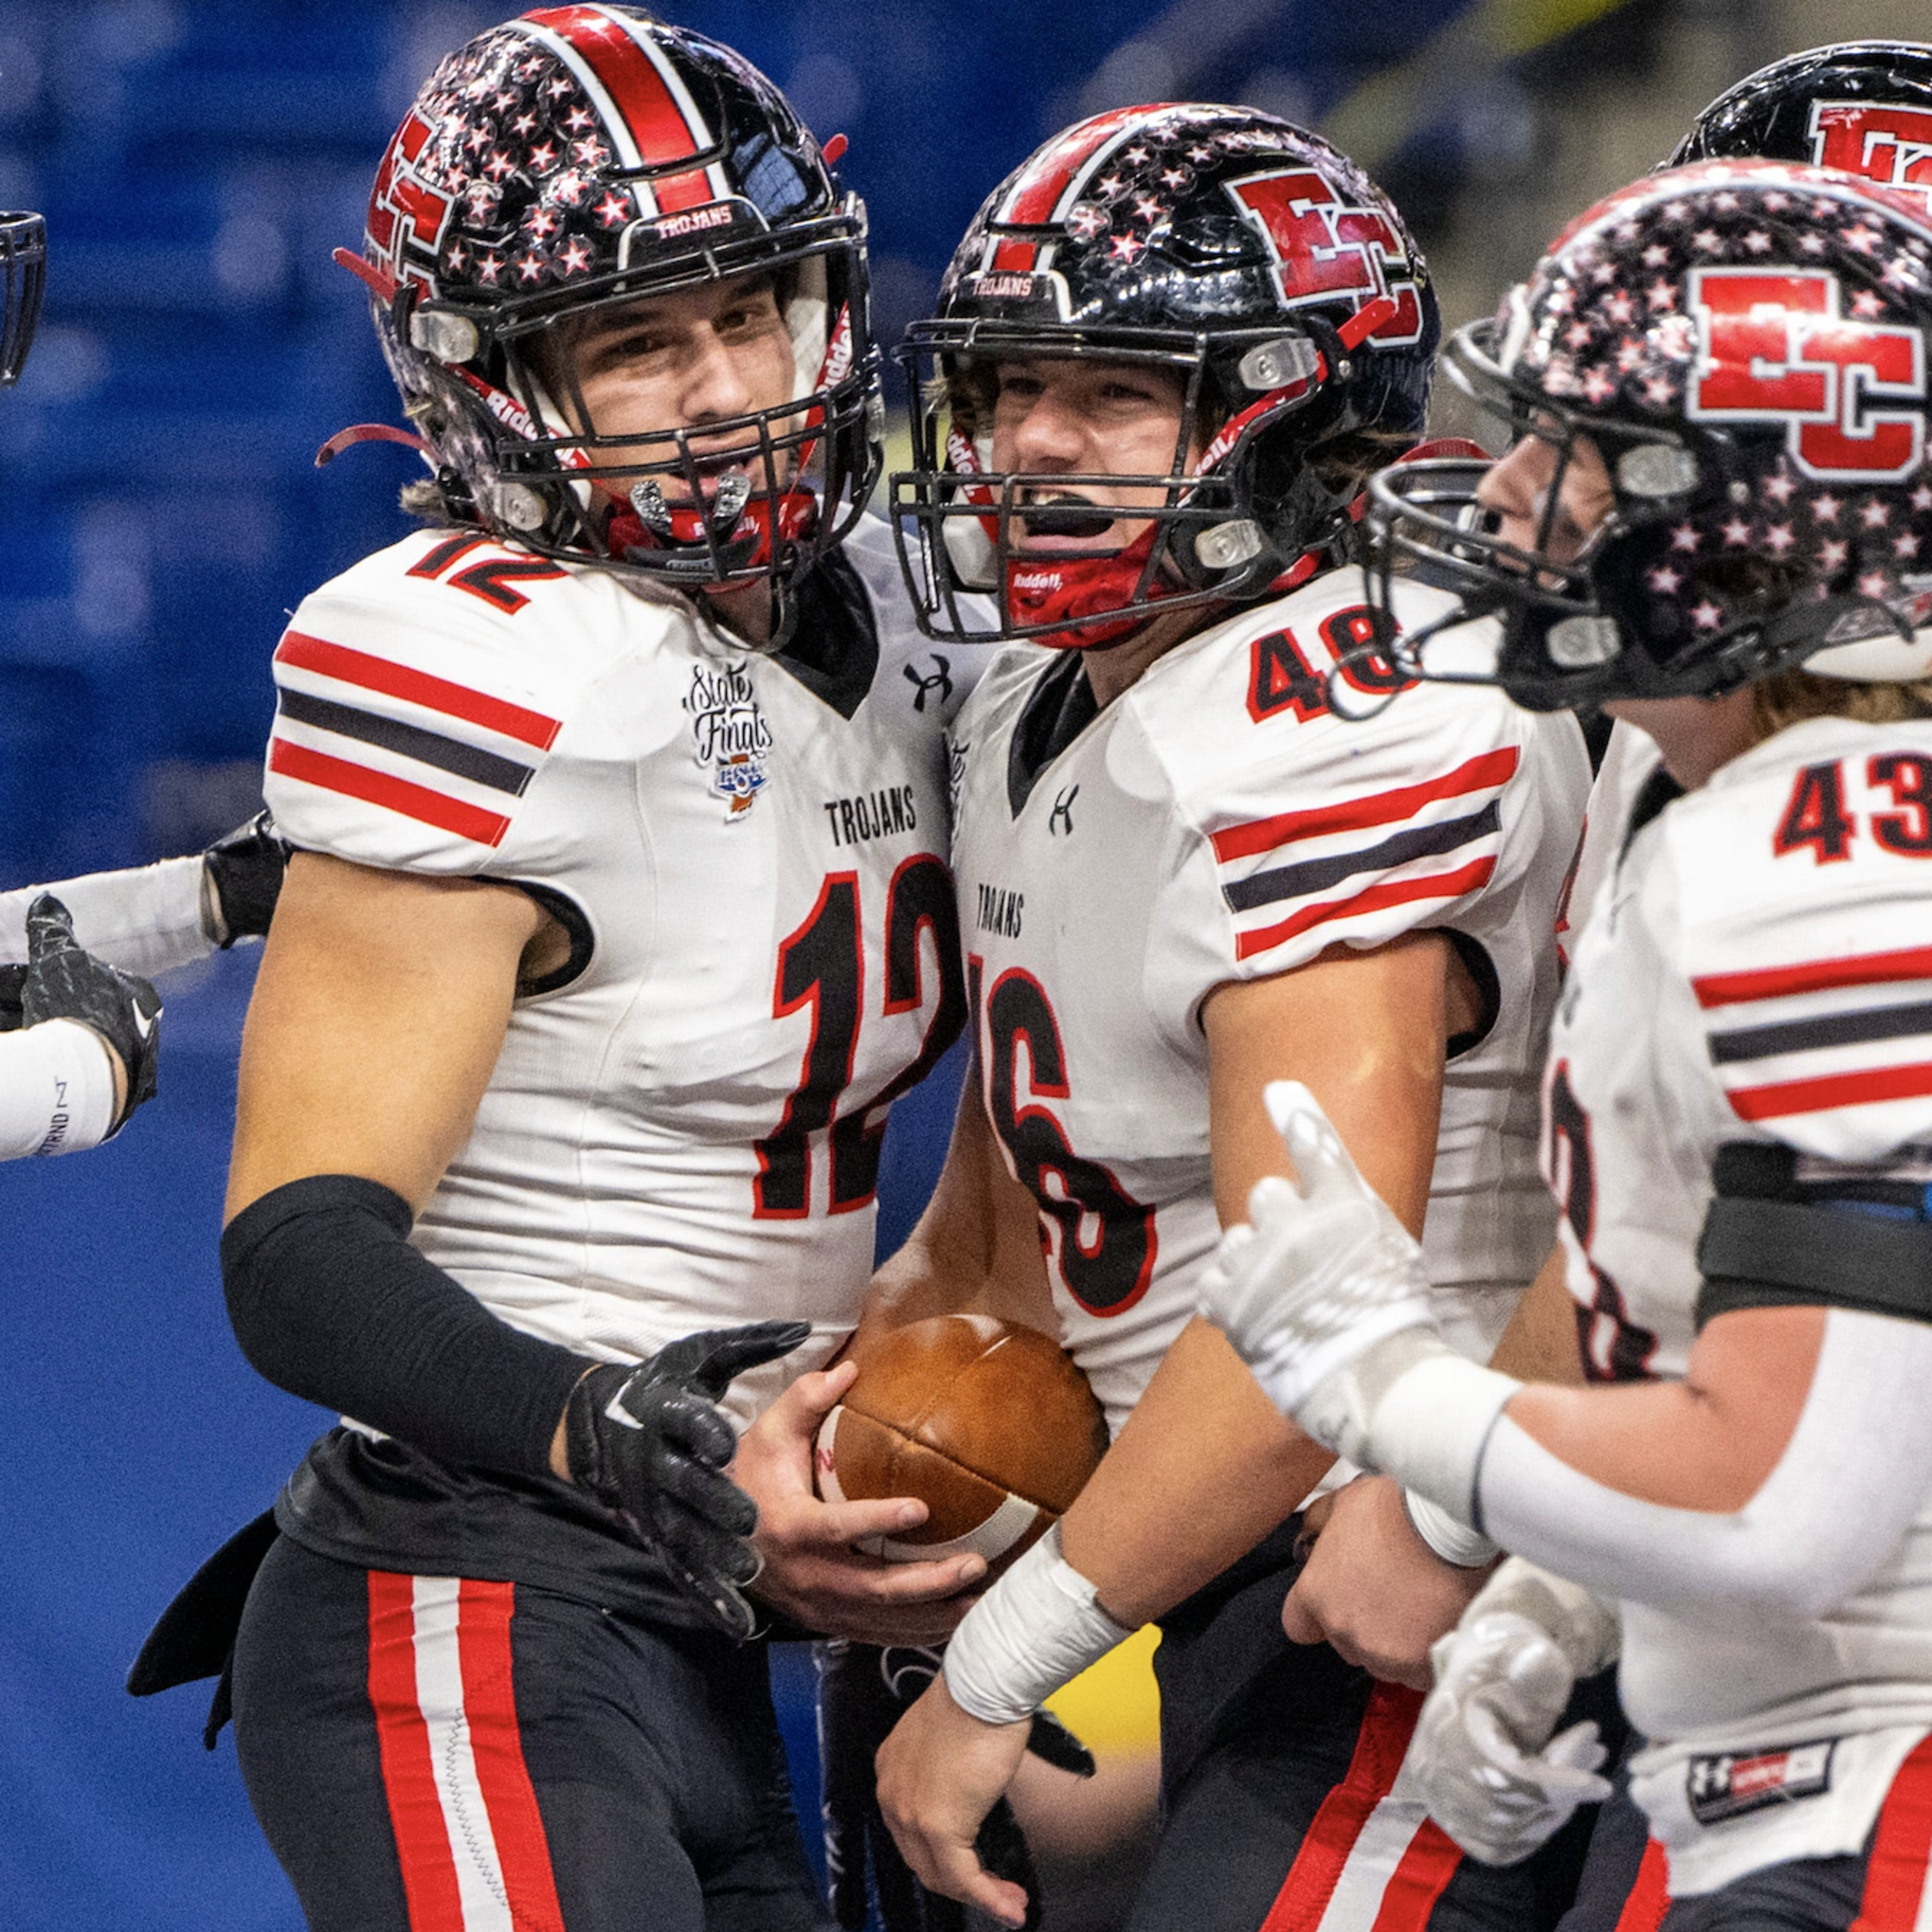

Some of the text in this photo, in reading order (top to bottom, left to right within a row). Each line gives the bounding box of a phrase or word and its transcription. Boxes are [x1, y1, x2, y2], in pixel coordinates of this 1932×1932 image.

[655, 204, 732, 239] TROJANS
[973, 276, 1032, 296] TROJANS
[1687, 266, 1924, 483] EC
[690, 659, 754, 710] State
[694, 702, 773, 762] Finals
[825, 785, 916, 847] TROJANS
[1773, 750, 1932, 866] 43
[977, 883, 1024, 939] TROJANS
[752, 852, 970, 1221] 12
[968, 952, 1158, 1318] 6
